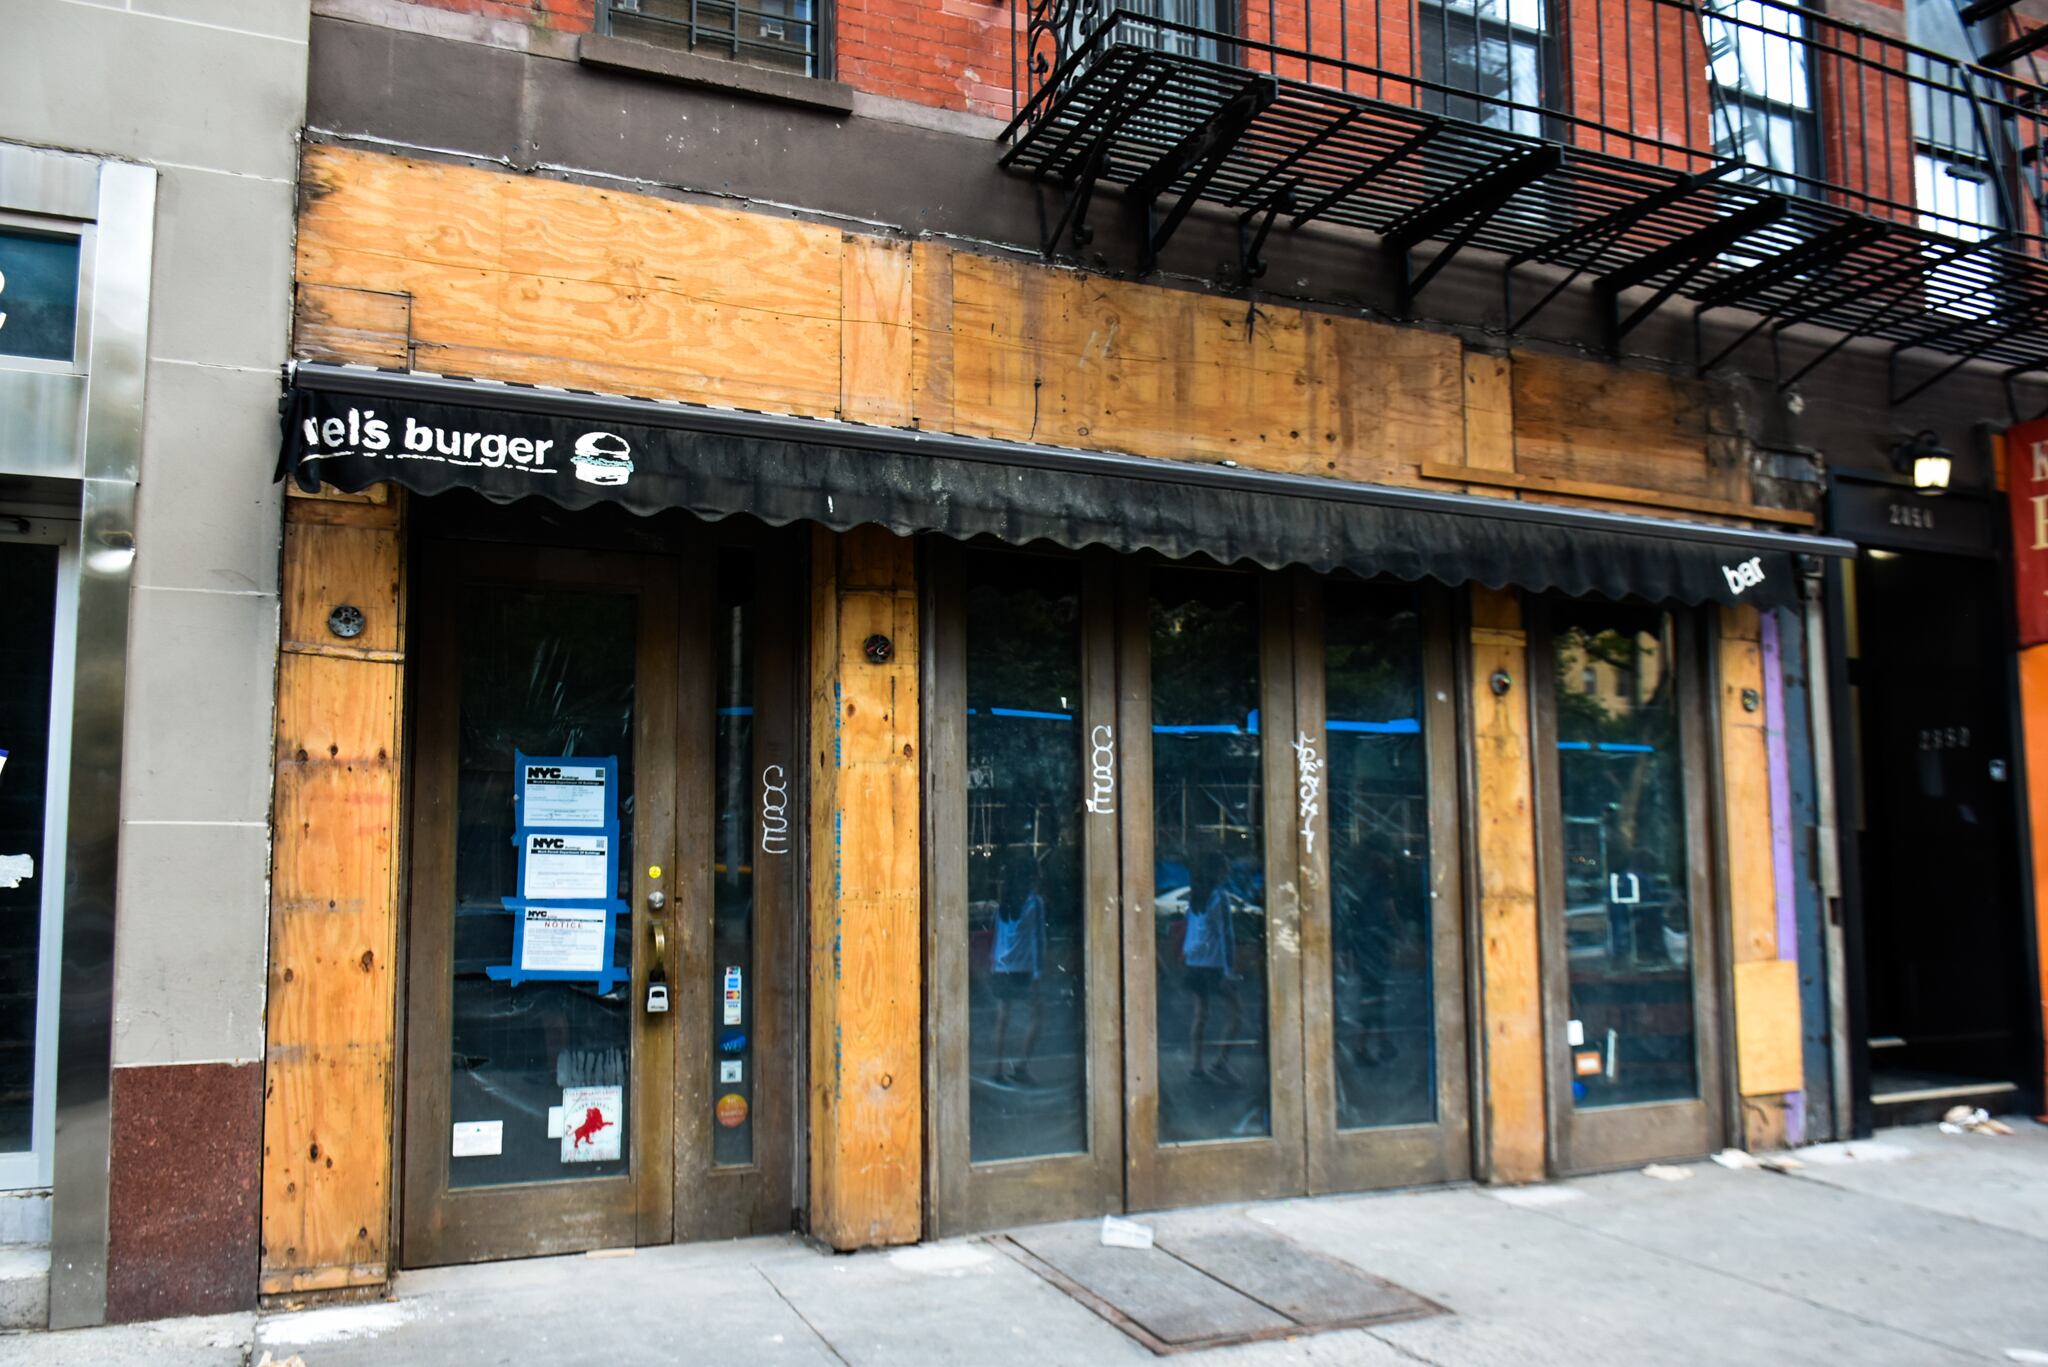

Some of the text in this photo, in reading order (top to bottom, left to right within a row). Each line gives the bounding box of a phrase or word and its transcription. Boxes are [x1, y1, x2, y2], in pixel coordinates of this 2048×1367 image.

[404, 417, 554, 468] burger
[1722, 556, 1766, 595] bar
[528, 767, 561, 779] NYC
[533, 838, 564, 849] NYC
